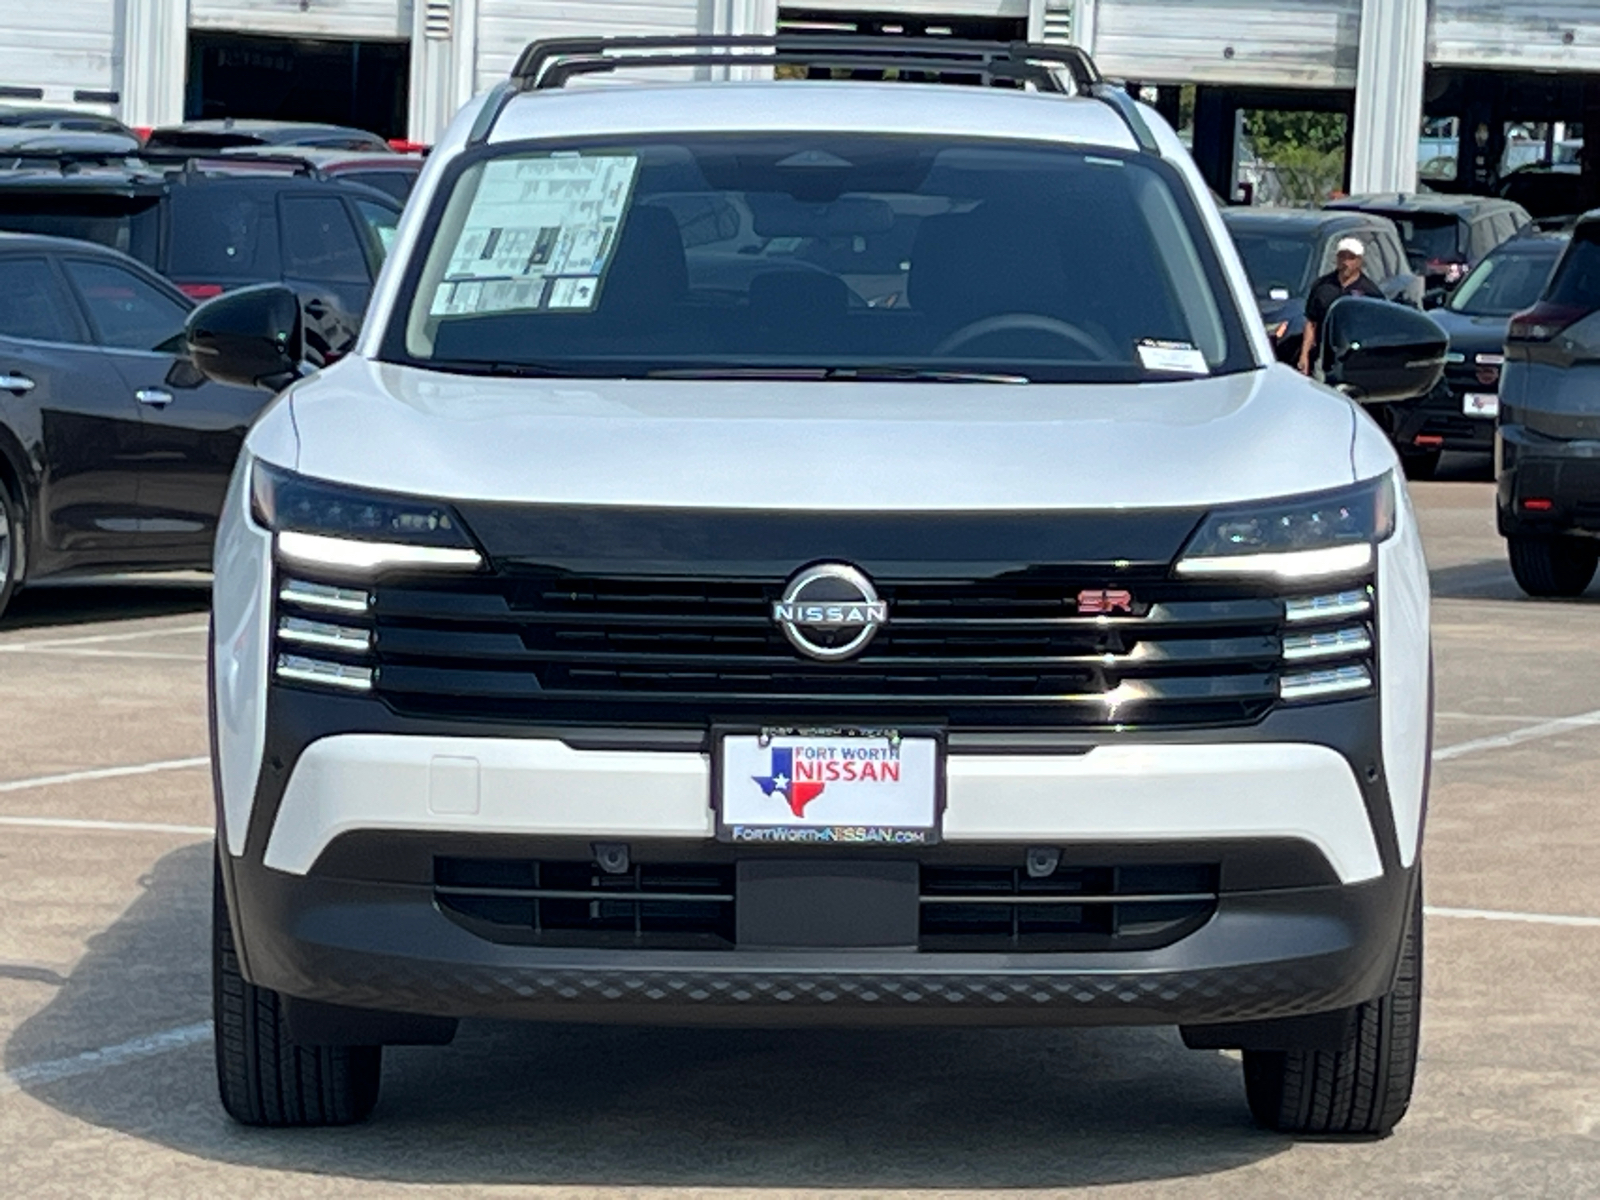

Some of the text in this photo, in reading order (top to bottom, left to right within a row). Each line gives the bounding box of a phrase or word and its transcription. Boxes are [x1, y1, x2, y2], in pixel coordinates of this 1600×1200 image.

[1078, 590, 1131, 612] SR
[775, 605, 885, 622] NISSAN
[795, 746, 900, 760] FORT WORTH
[795, 761, 900, 782] NISSAN
